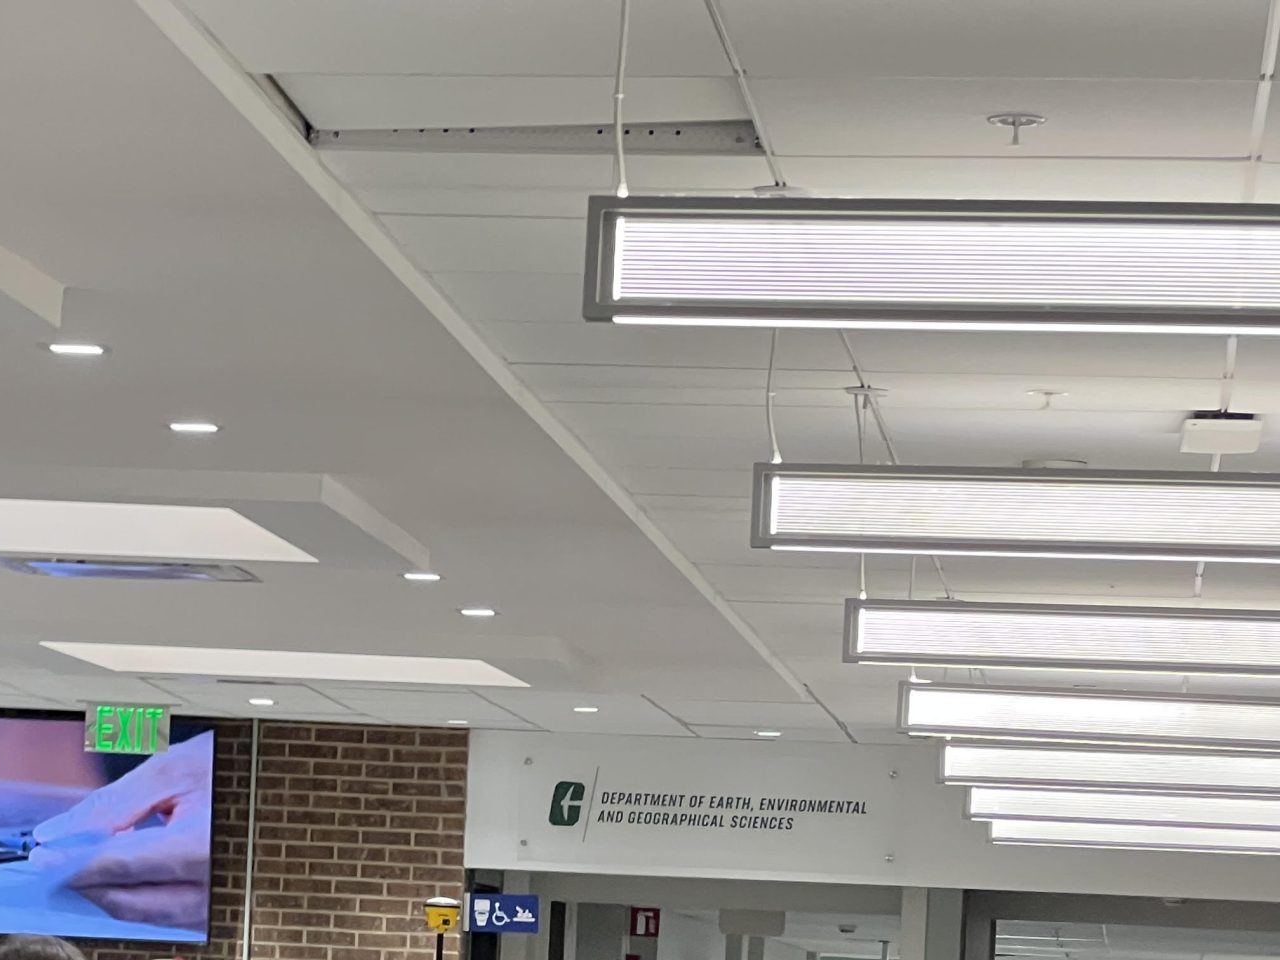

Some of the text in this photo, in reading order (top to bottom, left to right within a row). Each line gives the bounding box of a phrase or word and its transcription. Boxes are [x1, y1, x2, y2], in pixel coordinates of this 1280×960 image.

[96, 706, 164, 752] EXIT
[601, 791, 867, 814] DEPARTMENT OF EARTH, ENVIRONMENTAL
[597, 810, 794, 830] AND GEOGRAPHICAL SCIENCES
